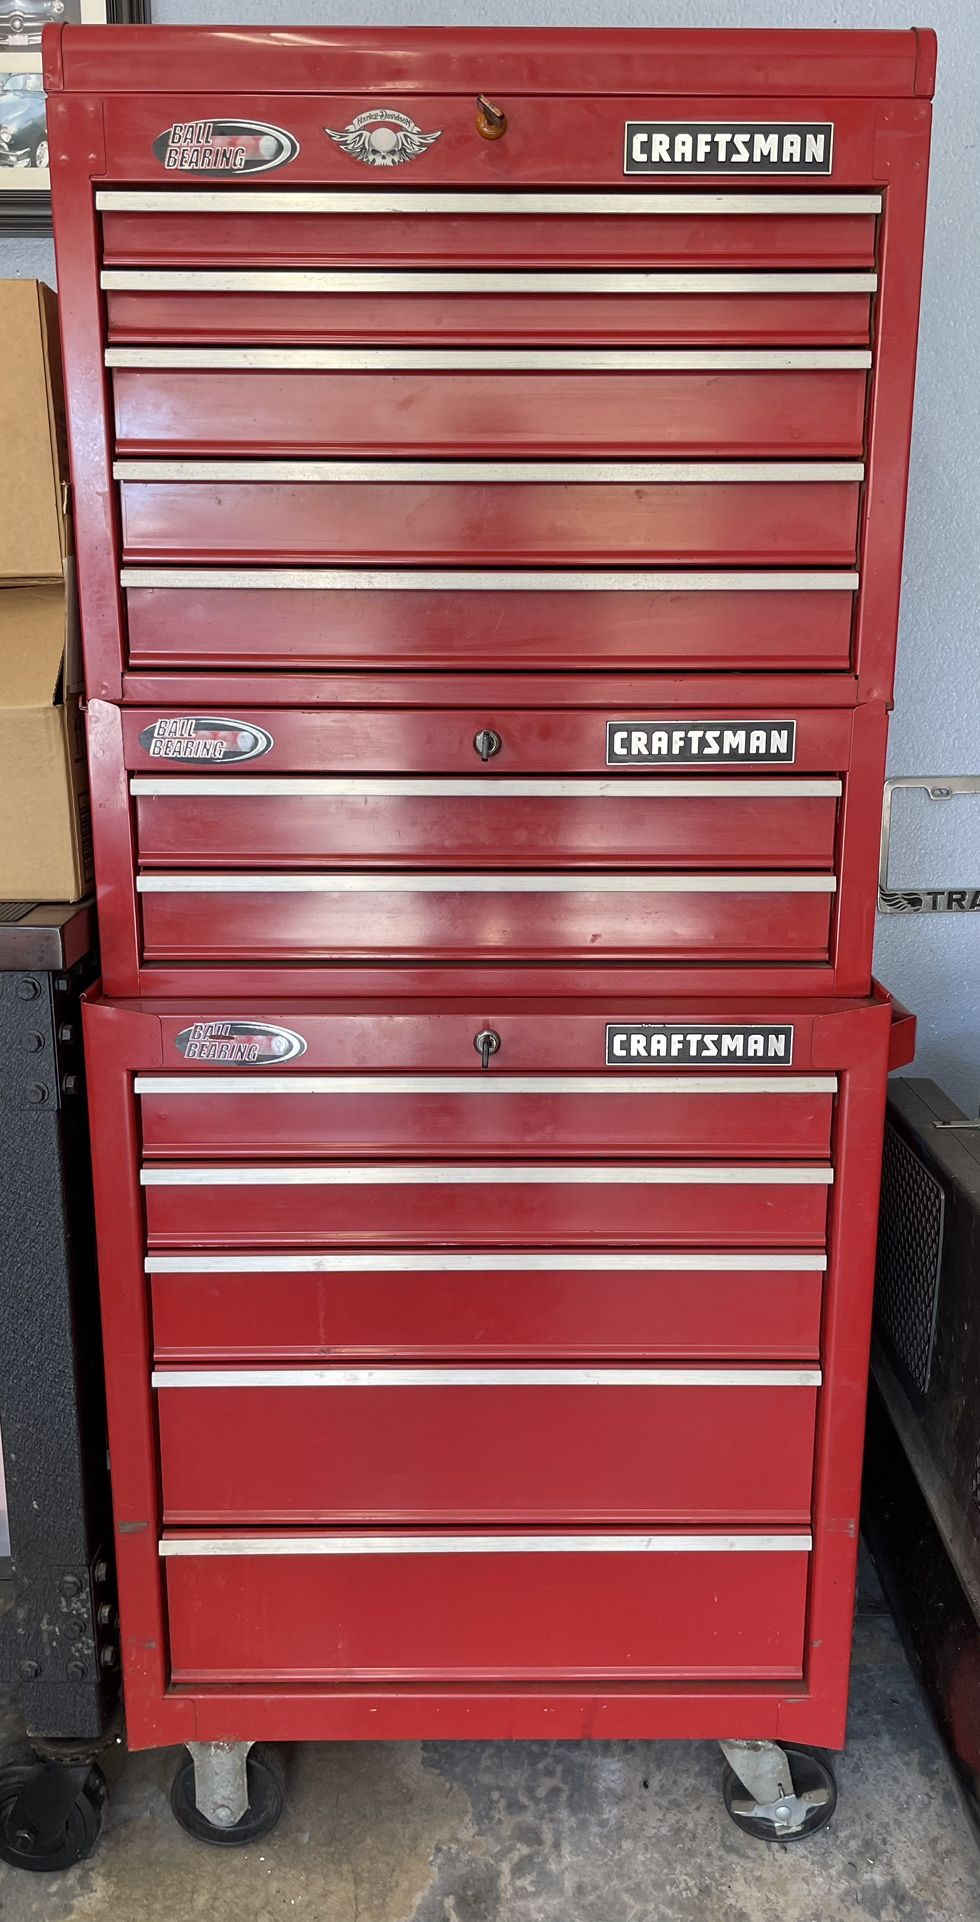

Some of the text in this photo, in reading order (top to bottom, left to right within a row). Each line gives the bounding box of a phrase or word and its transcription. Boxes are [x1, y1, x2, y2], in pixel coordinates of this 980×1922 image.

[169, 123, 213, 146] BALL
[165, 146, 246, 169] BEARING
[632, 133, 825, 162] CRAFTSMAN
[153, 719, 197, 738] BALL
[150, 738, 225, 758] BEARING
[613, 730, 788, 755] CRAFTSMAN
[184, 1042, 260, 1061] BEARING
[613, 1034, 786, 1057] CRAFTSMAN
